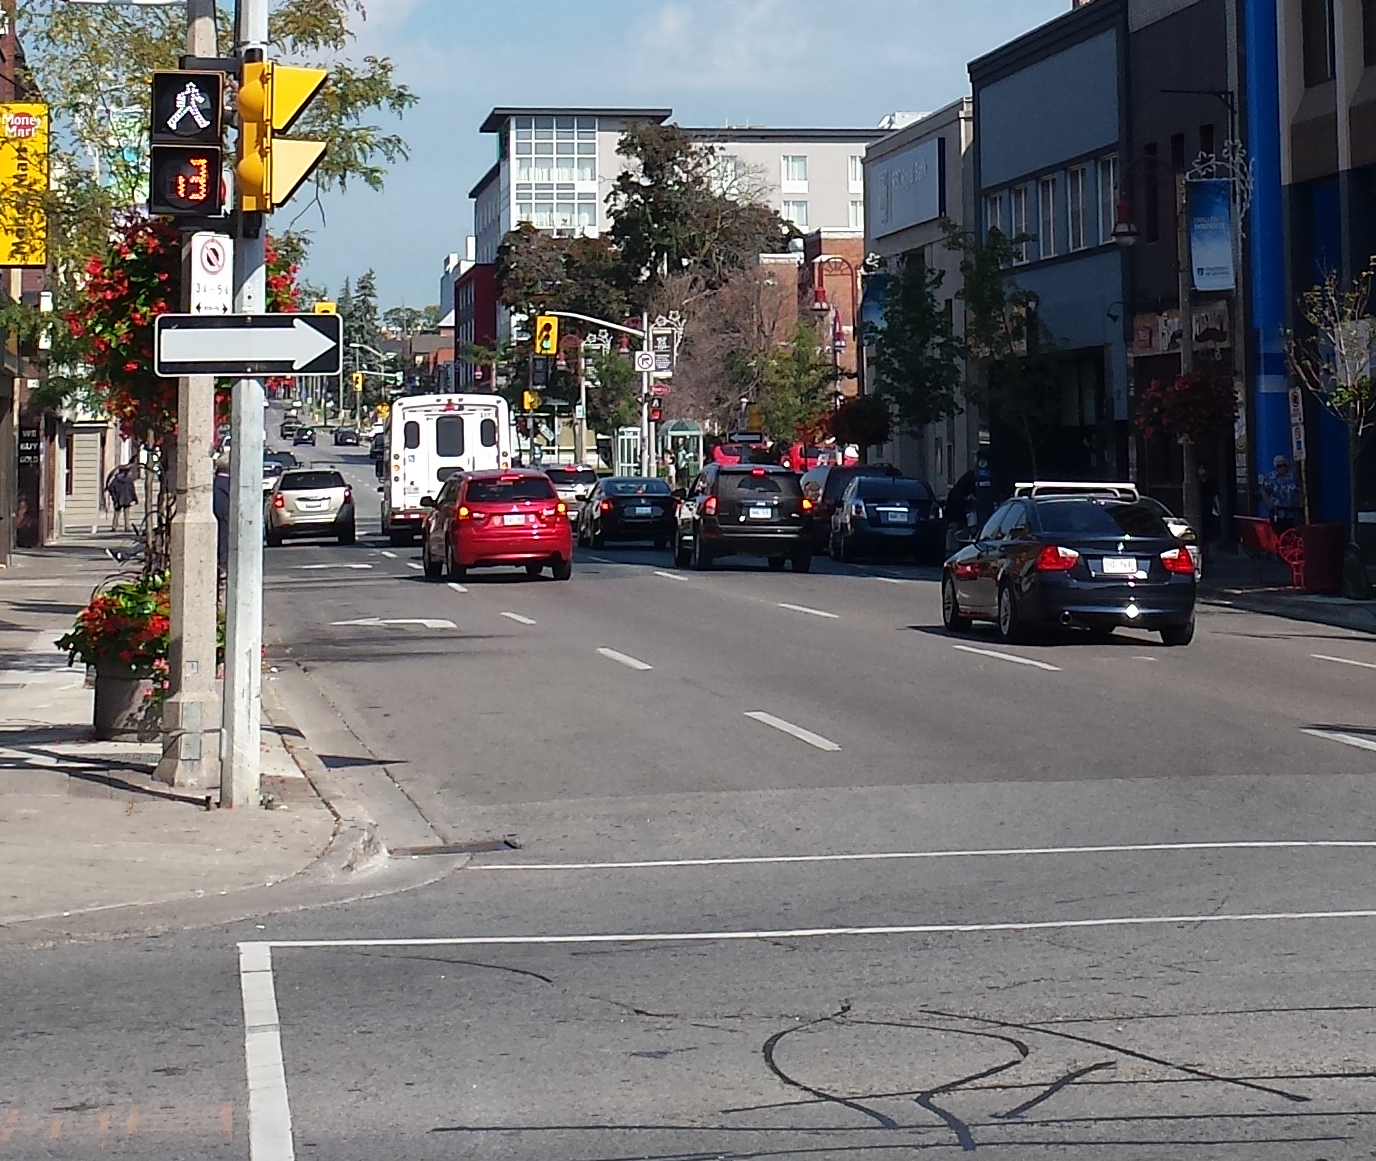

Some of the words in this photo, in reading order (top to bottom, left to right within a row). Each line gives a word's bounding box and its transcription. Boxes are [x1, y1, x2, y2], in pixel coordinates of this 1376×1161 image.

[22, 429, 37, 438] WE
[20, 442, 39, 451] BUY
[19, 455, 39, 464] GOLD
